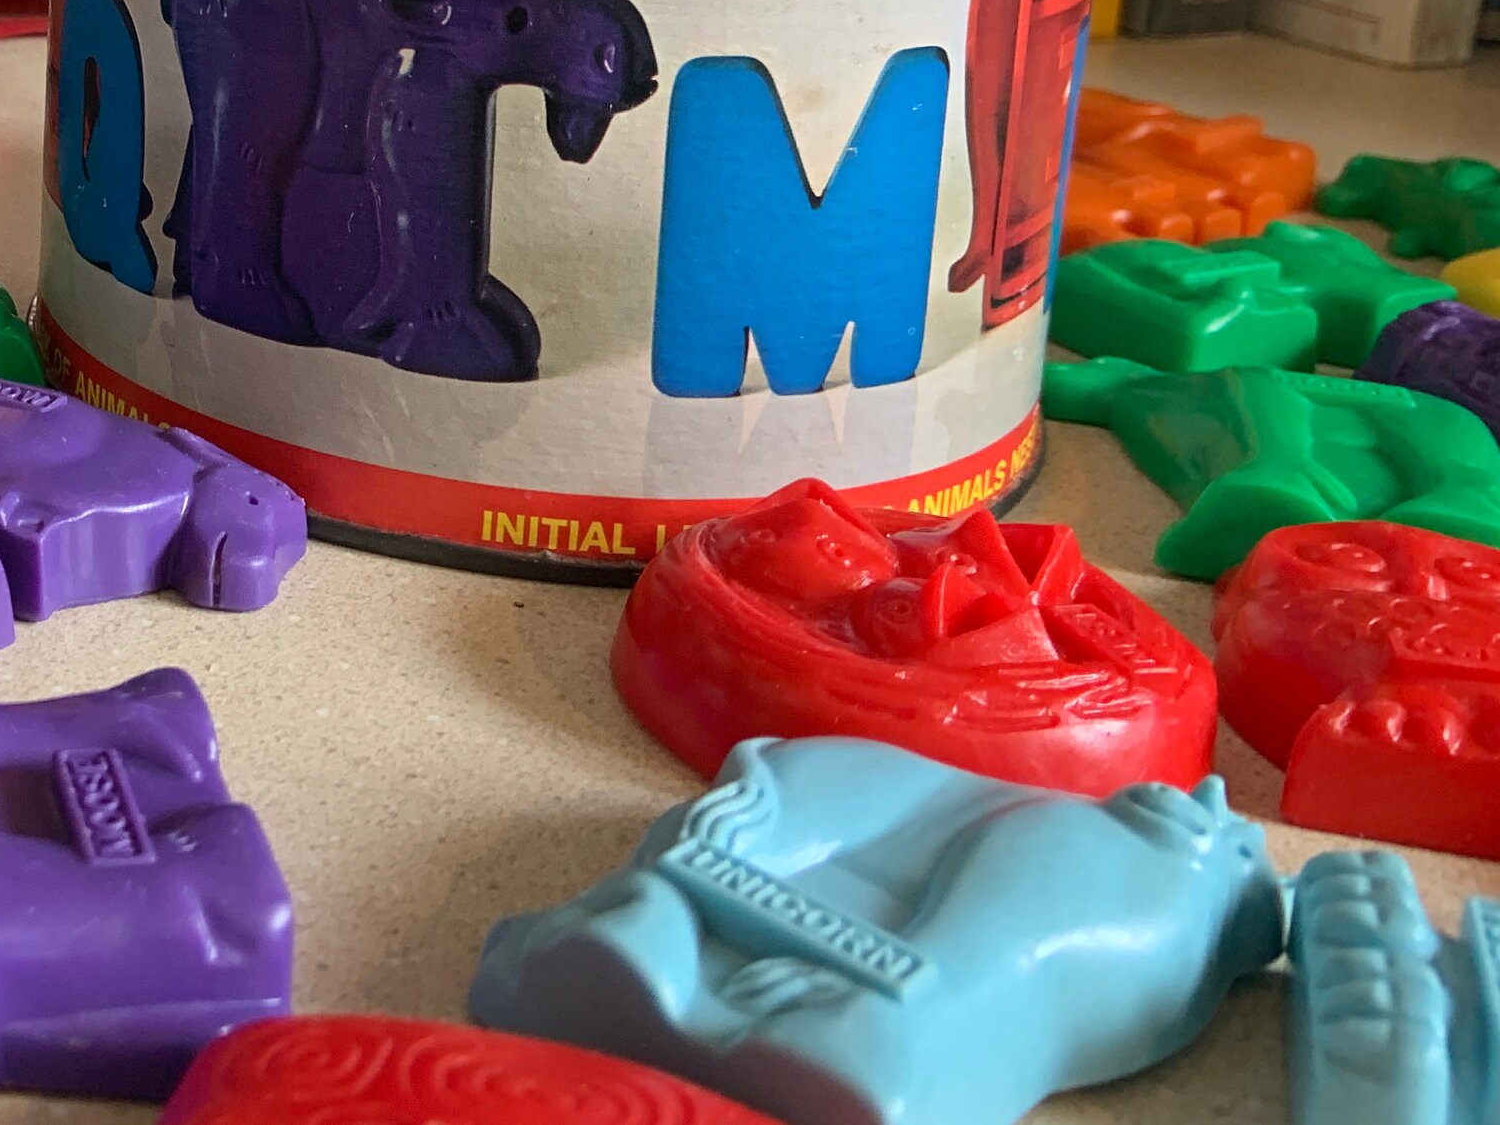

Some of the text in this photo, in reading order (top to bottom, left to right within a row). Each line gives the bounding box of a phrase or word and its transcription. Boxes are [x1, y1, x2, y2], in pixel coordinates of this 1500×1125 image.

[481, 509, 637, 556] INITIAL
[72, 755, 137, 858] MOOSE
[686, 847, 919, 981] UNICORN
